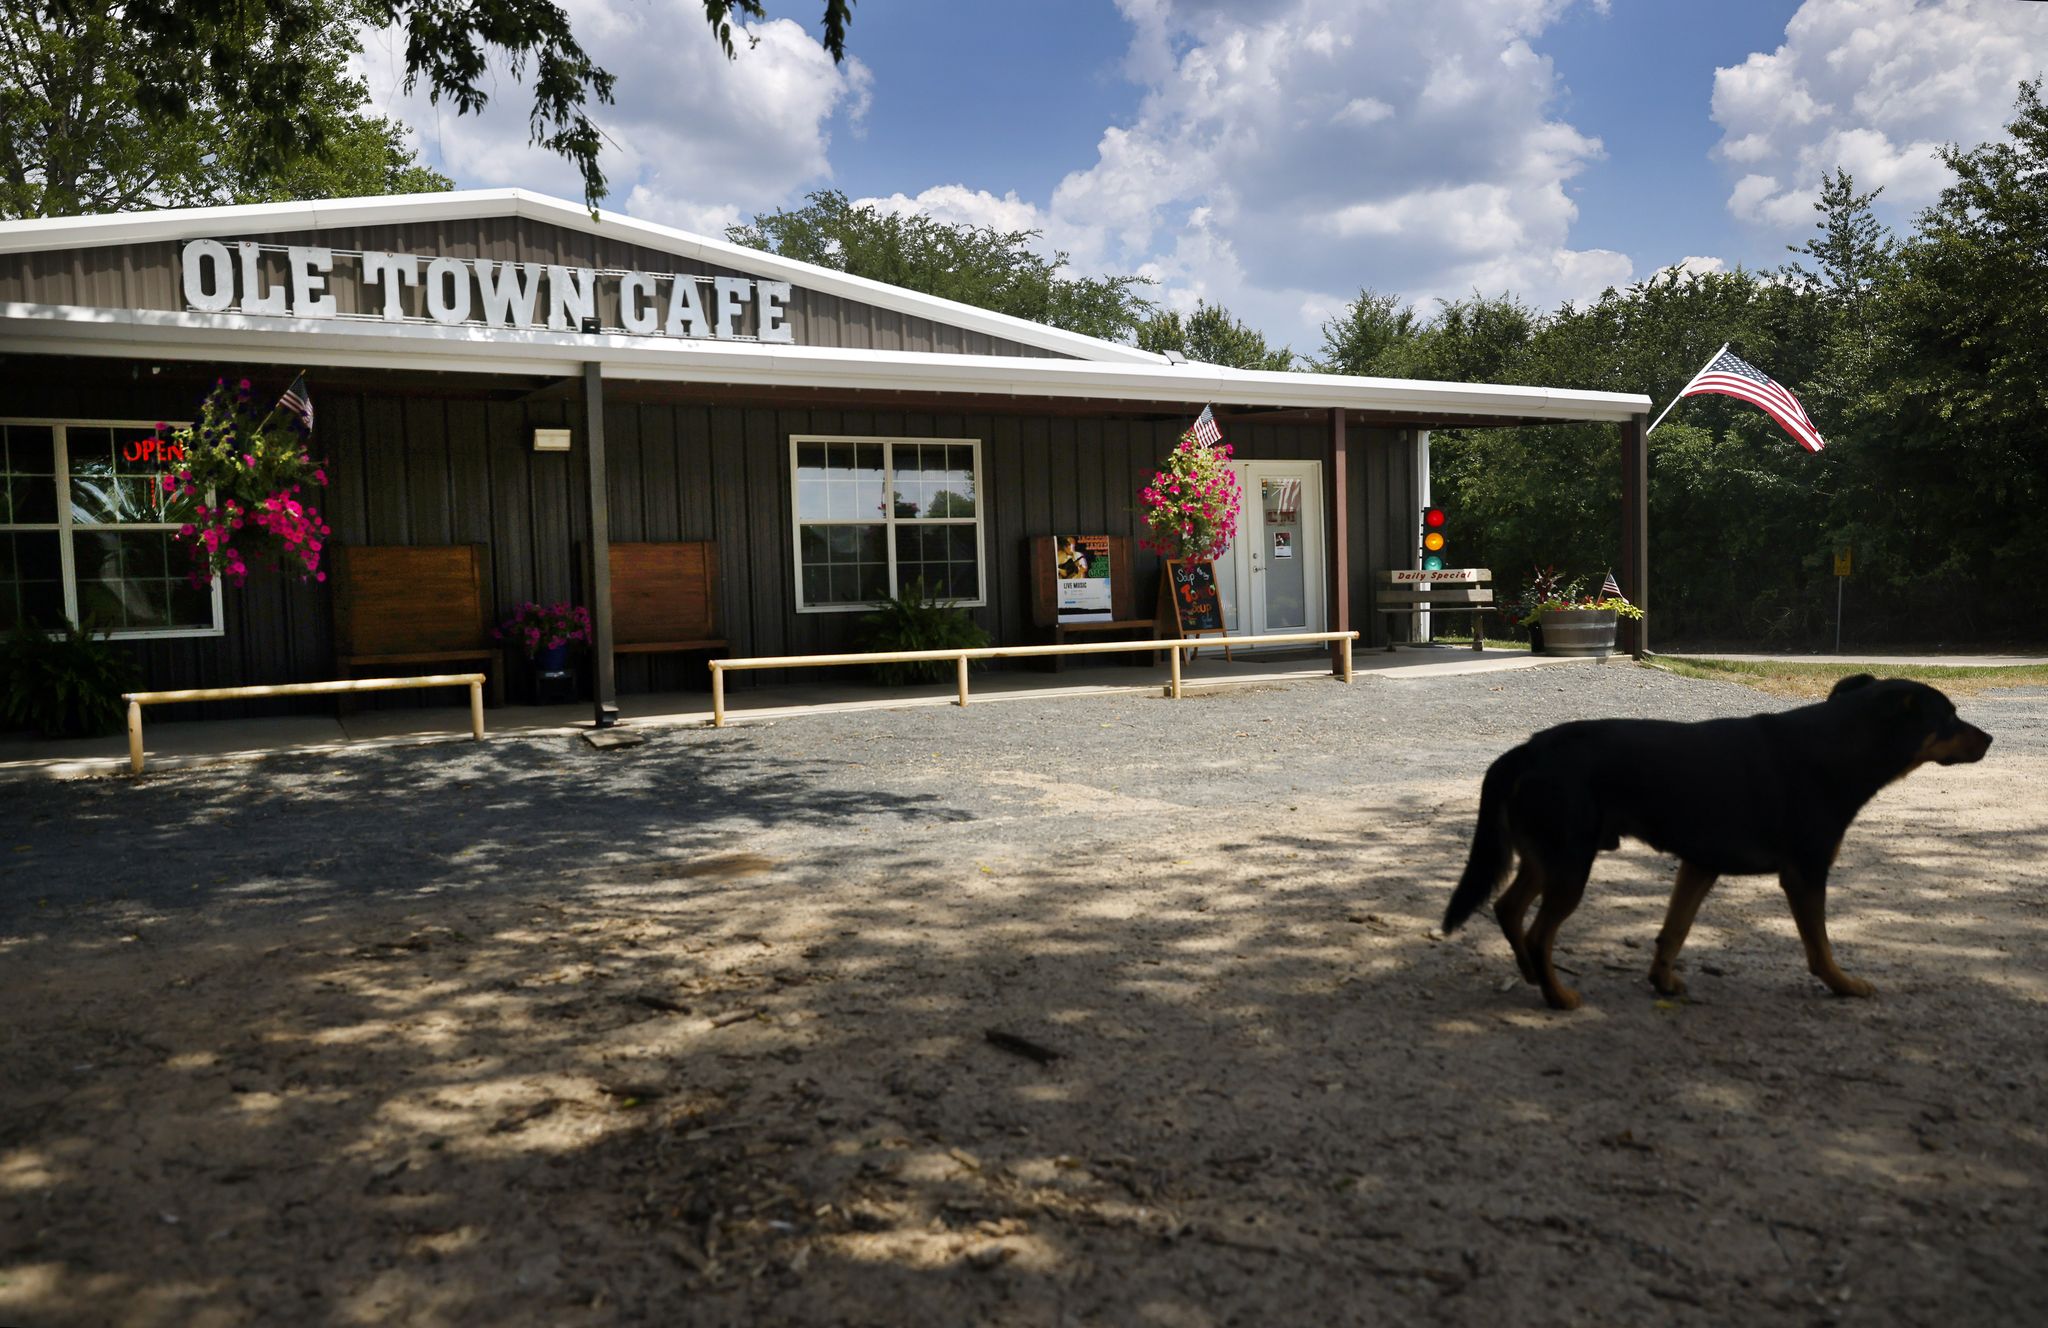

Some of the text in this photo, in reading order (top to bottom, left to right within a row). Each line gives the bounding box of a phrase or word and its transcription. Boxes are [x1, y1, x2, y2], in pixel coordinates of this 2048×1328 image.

[182, 239, 792, 343] OLE TOWN CAFE
[123, 438, 184, 461] OPEN
[1398, 571, 1472, 581] Daily Special
[1073, 581, 1087, 589] MUSIC
